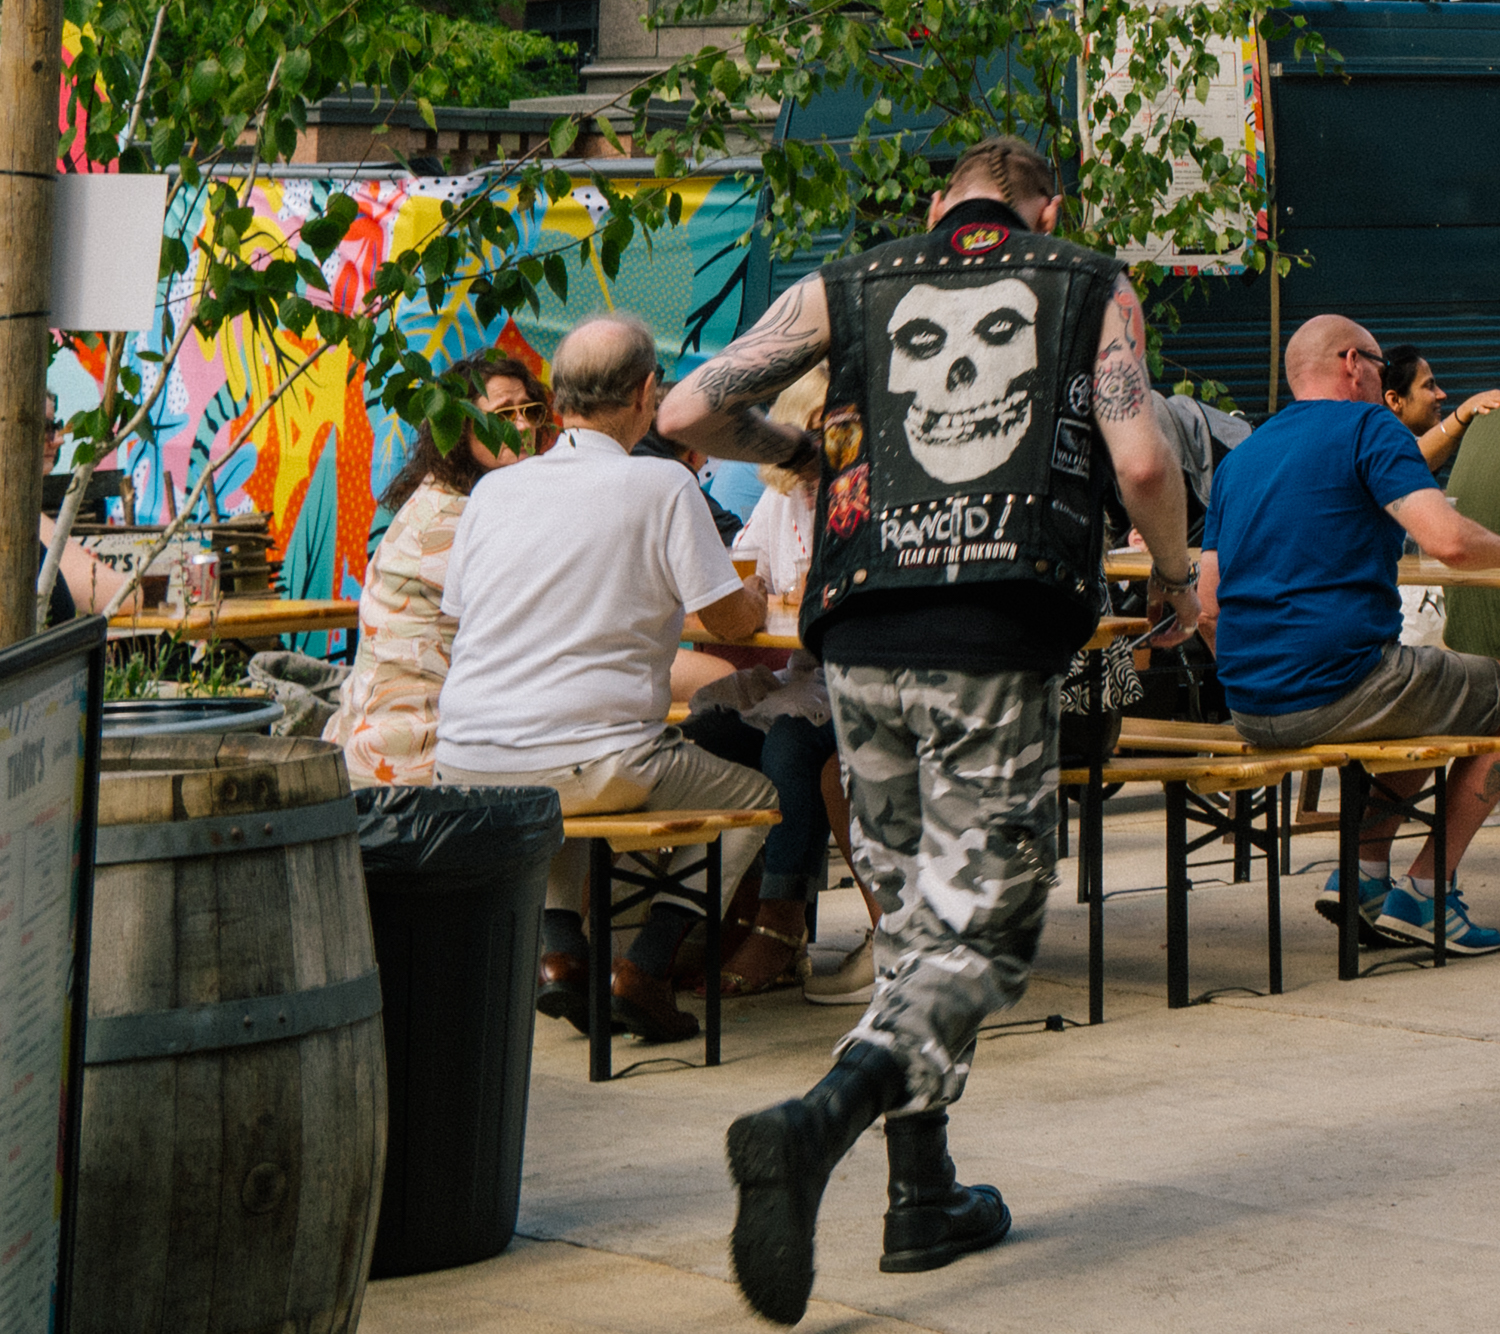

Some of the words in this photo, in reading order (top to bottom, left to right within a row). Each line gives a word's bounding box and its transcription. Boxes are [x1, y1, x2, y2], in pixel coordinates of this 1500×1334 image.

[898, 548, 927, 567] FEAR
[927, 547, 942, 565] OF
[943, 545, 962, 564] THE
[963, 542, 1018, 562] UNKNOWN
